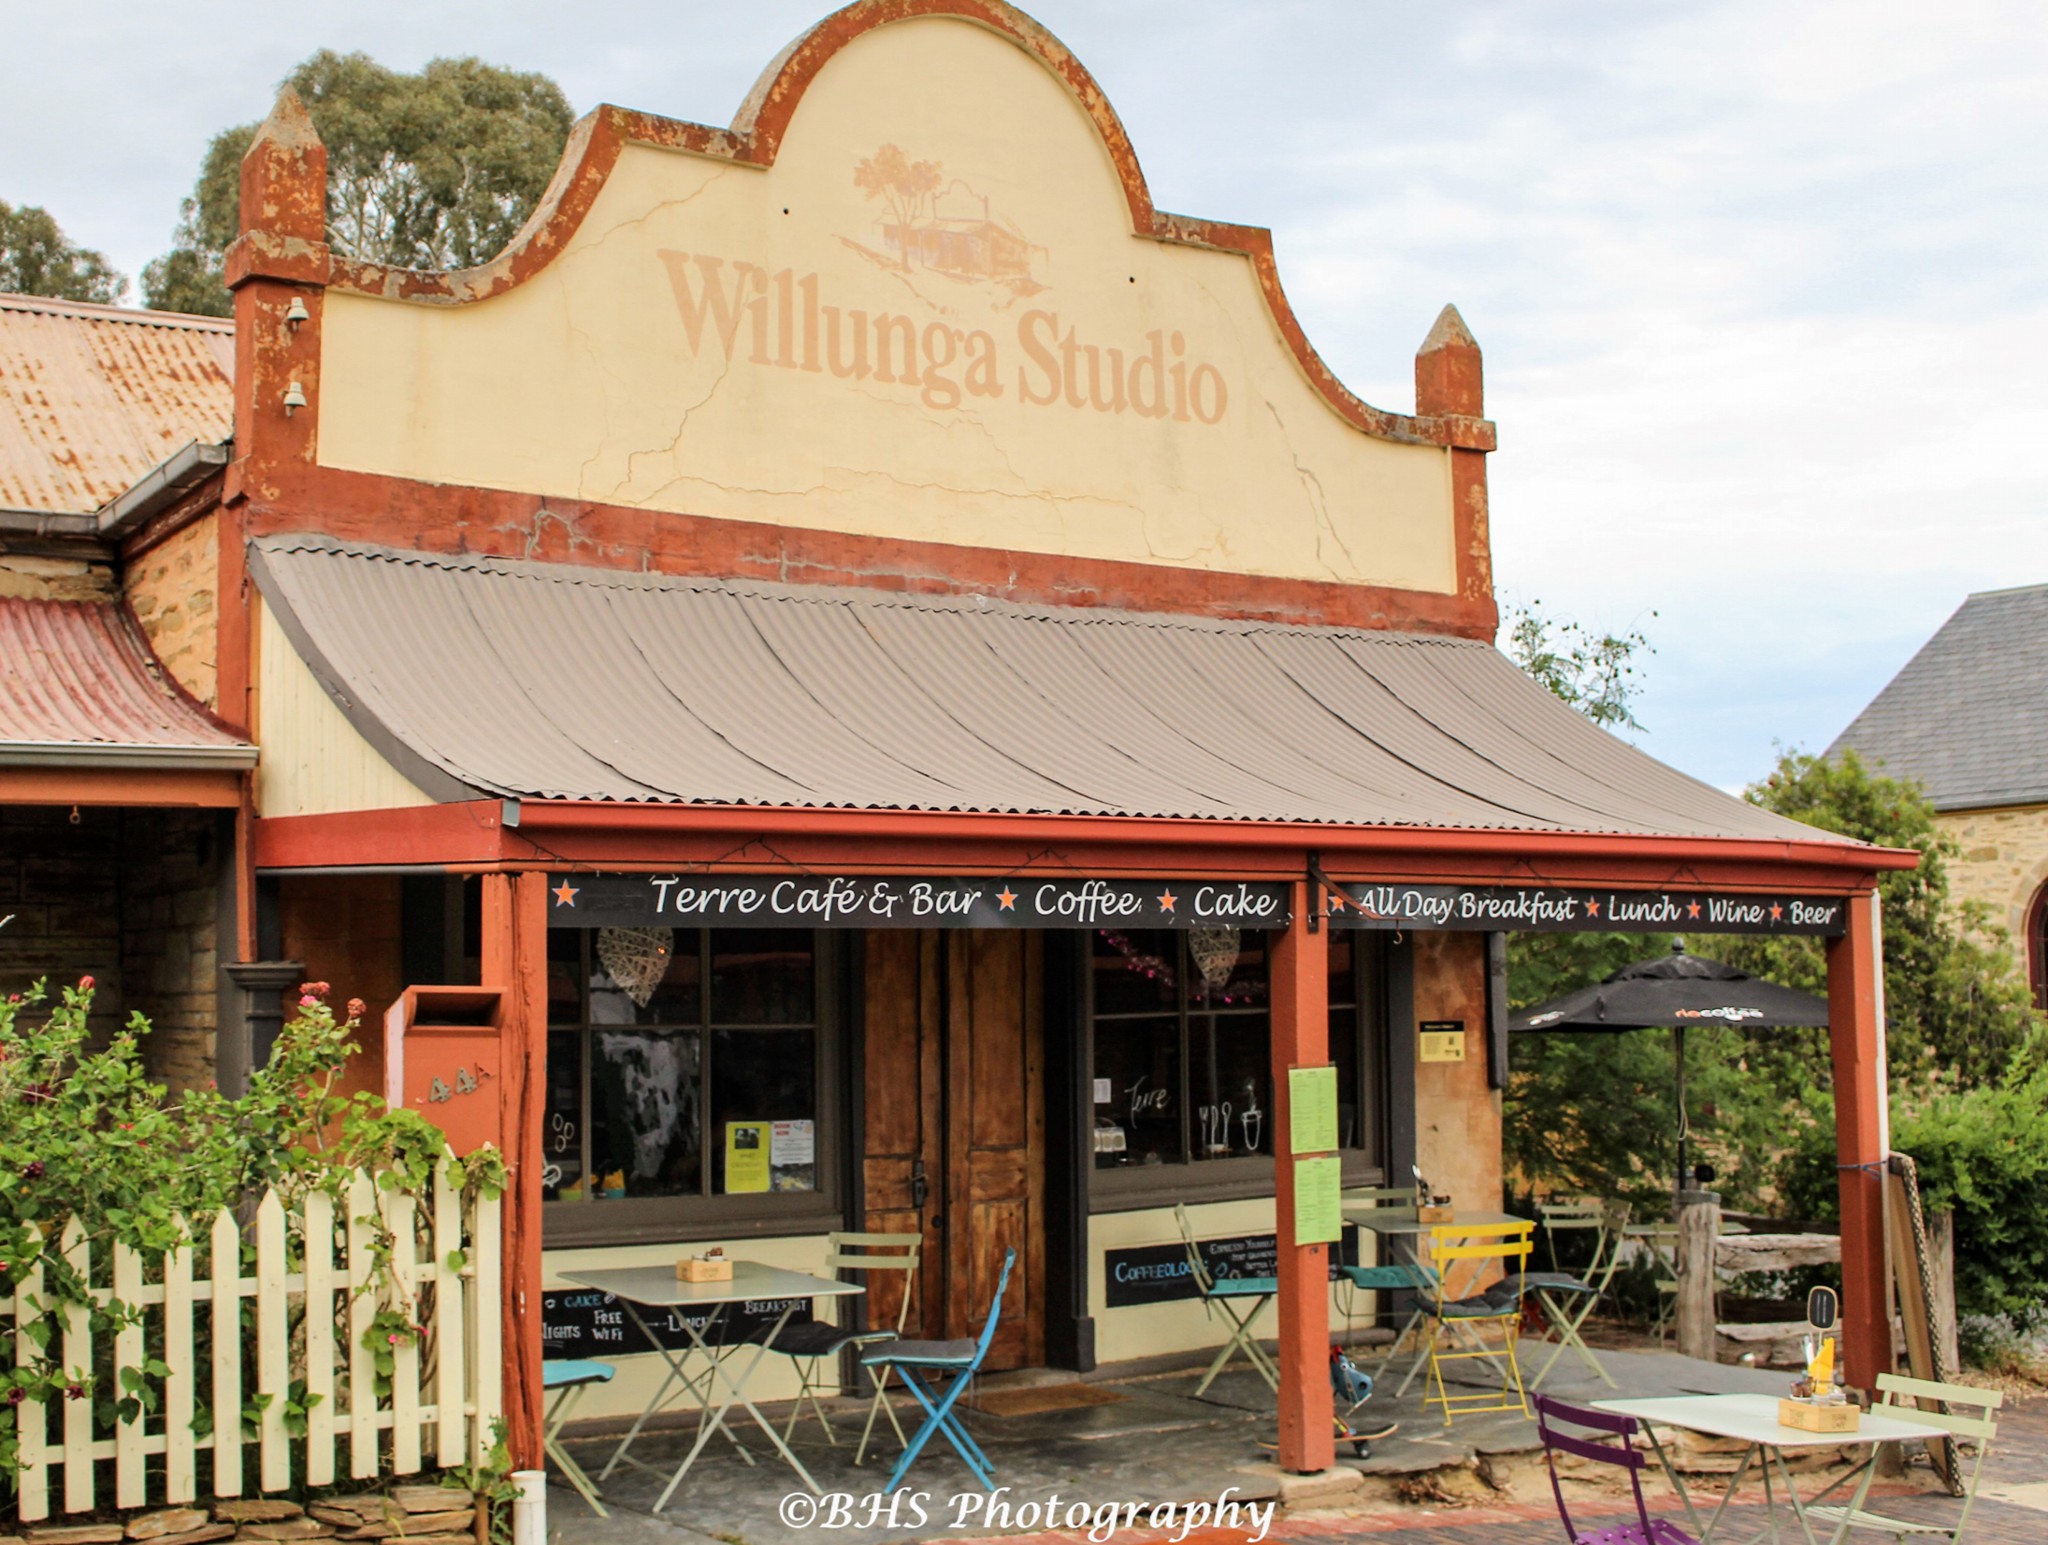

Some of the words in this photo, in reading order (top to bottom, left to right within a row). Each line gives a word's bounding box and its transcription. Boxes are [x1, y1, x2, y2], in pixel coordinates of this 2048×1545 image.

[657, 248, 1003, 410] Willunga
[1017, 308, 1227, 425] Studio
[651, 877, 766, 914] Terre
[770, 877, 865, 922] Café
[868, 882, 898, 918] &
[909, 882, 982, 916] Bar
[1034, 881, 1141, 922] Coffee
[1194, 883, 1278, 917] Cake
[1359, 886, 1401, 916] All
[1402, 890, 1454, 925] Day
[1459, 891, 1579, 924] Breakfast
[1608, 895, 1682, 922] Lunch
[1708, 898, 1765, 924] Wine
[1789, 900, 1838, 926] Beer
[593, 1309, 623, 1325] FREE
